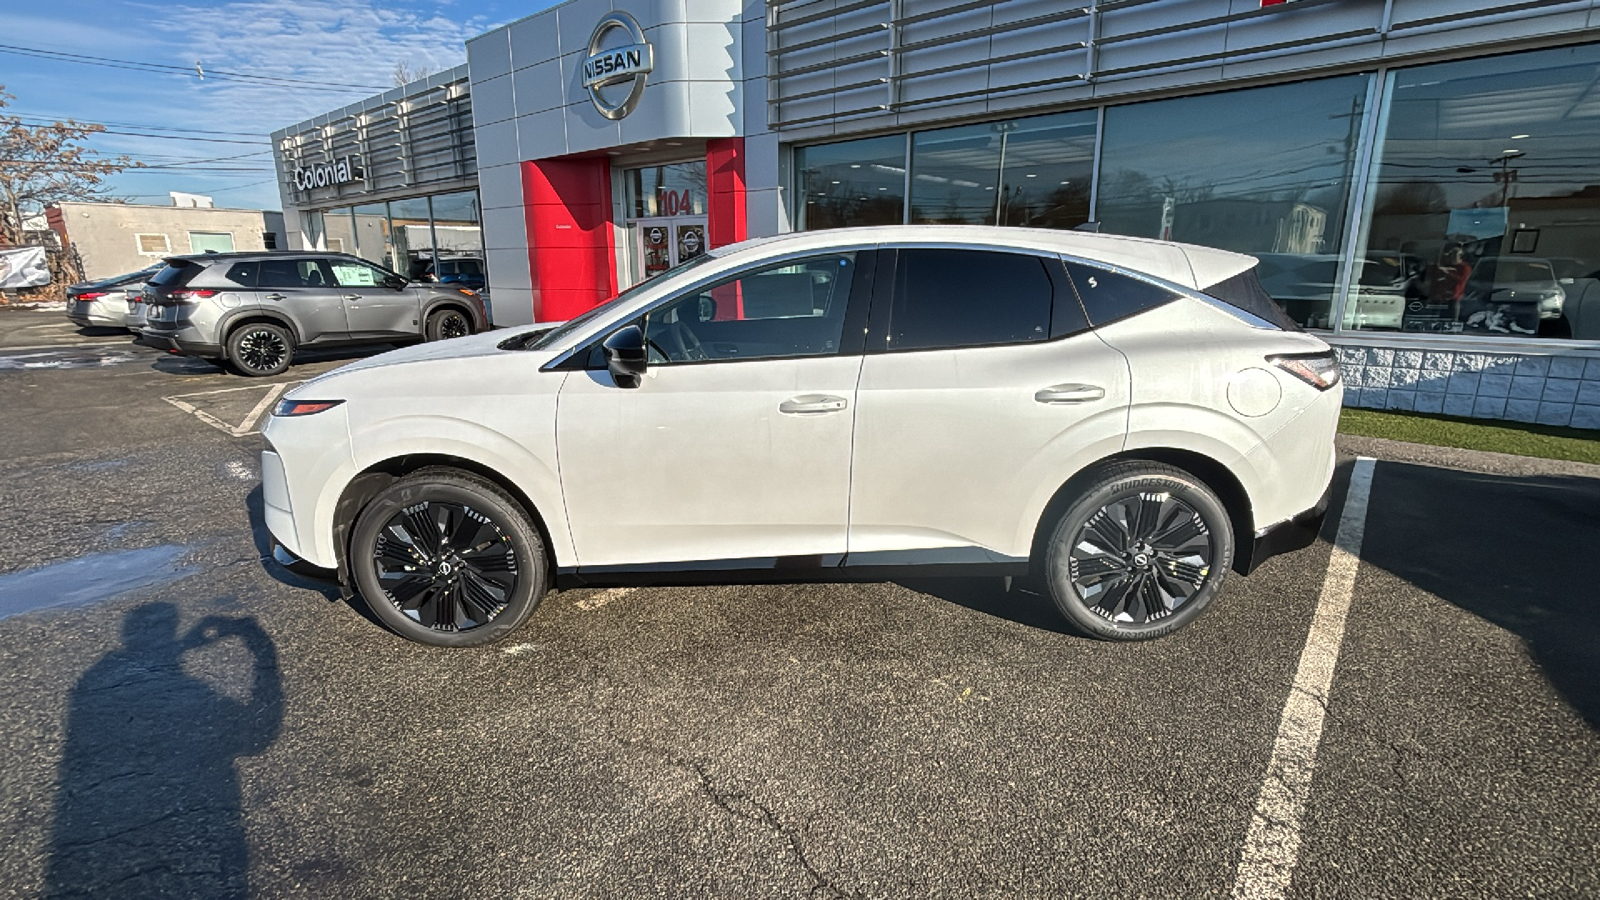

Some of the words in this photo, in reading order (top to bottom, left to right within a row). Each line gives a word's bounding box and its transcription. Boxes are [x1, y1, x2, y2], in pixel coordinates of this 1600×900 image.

[584, 49, 641, 81] NISSAN
[294, 154, 352, 191] Colonial
[658, 188, 692, 216] 104
